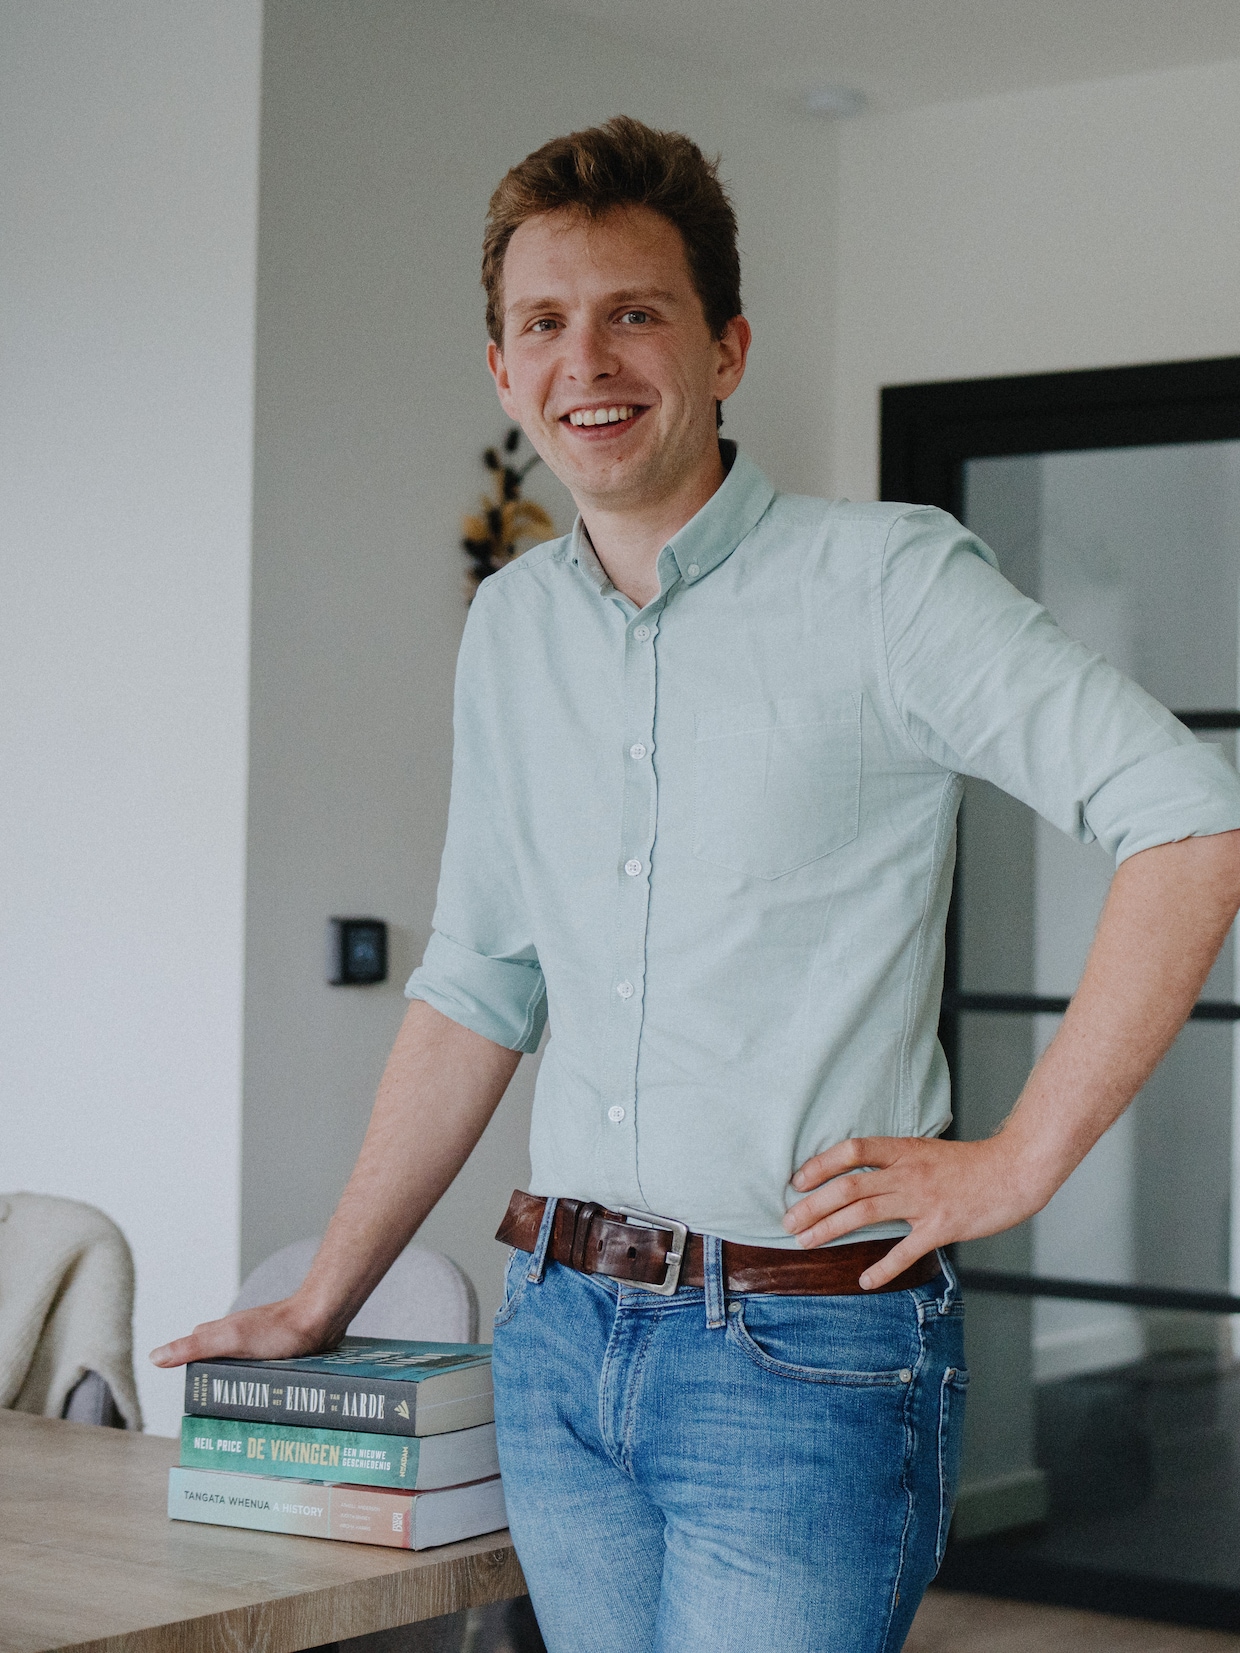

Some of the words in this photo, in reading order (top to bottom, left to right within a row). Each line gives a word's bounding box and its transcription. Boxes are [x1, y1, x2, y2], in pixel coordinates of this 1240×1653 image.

[213, 1378, 270, 1408] WAANZIN
[286, 1386, 326, 1414] EINDE
[342, 1391, 385, 1419] AARDE
[194, 1437, 214, 1450] NEIL
[216, 1439, 242, 1453] PRICE
[247, 1437, 266, 1460] DE
[271, 1440, 340, 1467] VIKINGEN
[343, 1447, 357, 1457] EEN
[359, 1448, 386, 1460] NIEUWE
[342, 1458, 391, 1471] GESCHIEDENIS
[184, 1490, 226, 1505] TANGATA
[228, 1496, 270, 1510] WHENUA
[272, 1502, 280, 1512] A
[281, 1503, 324, 1517] HISTORY
